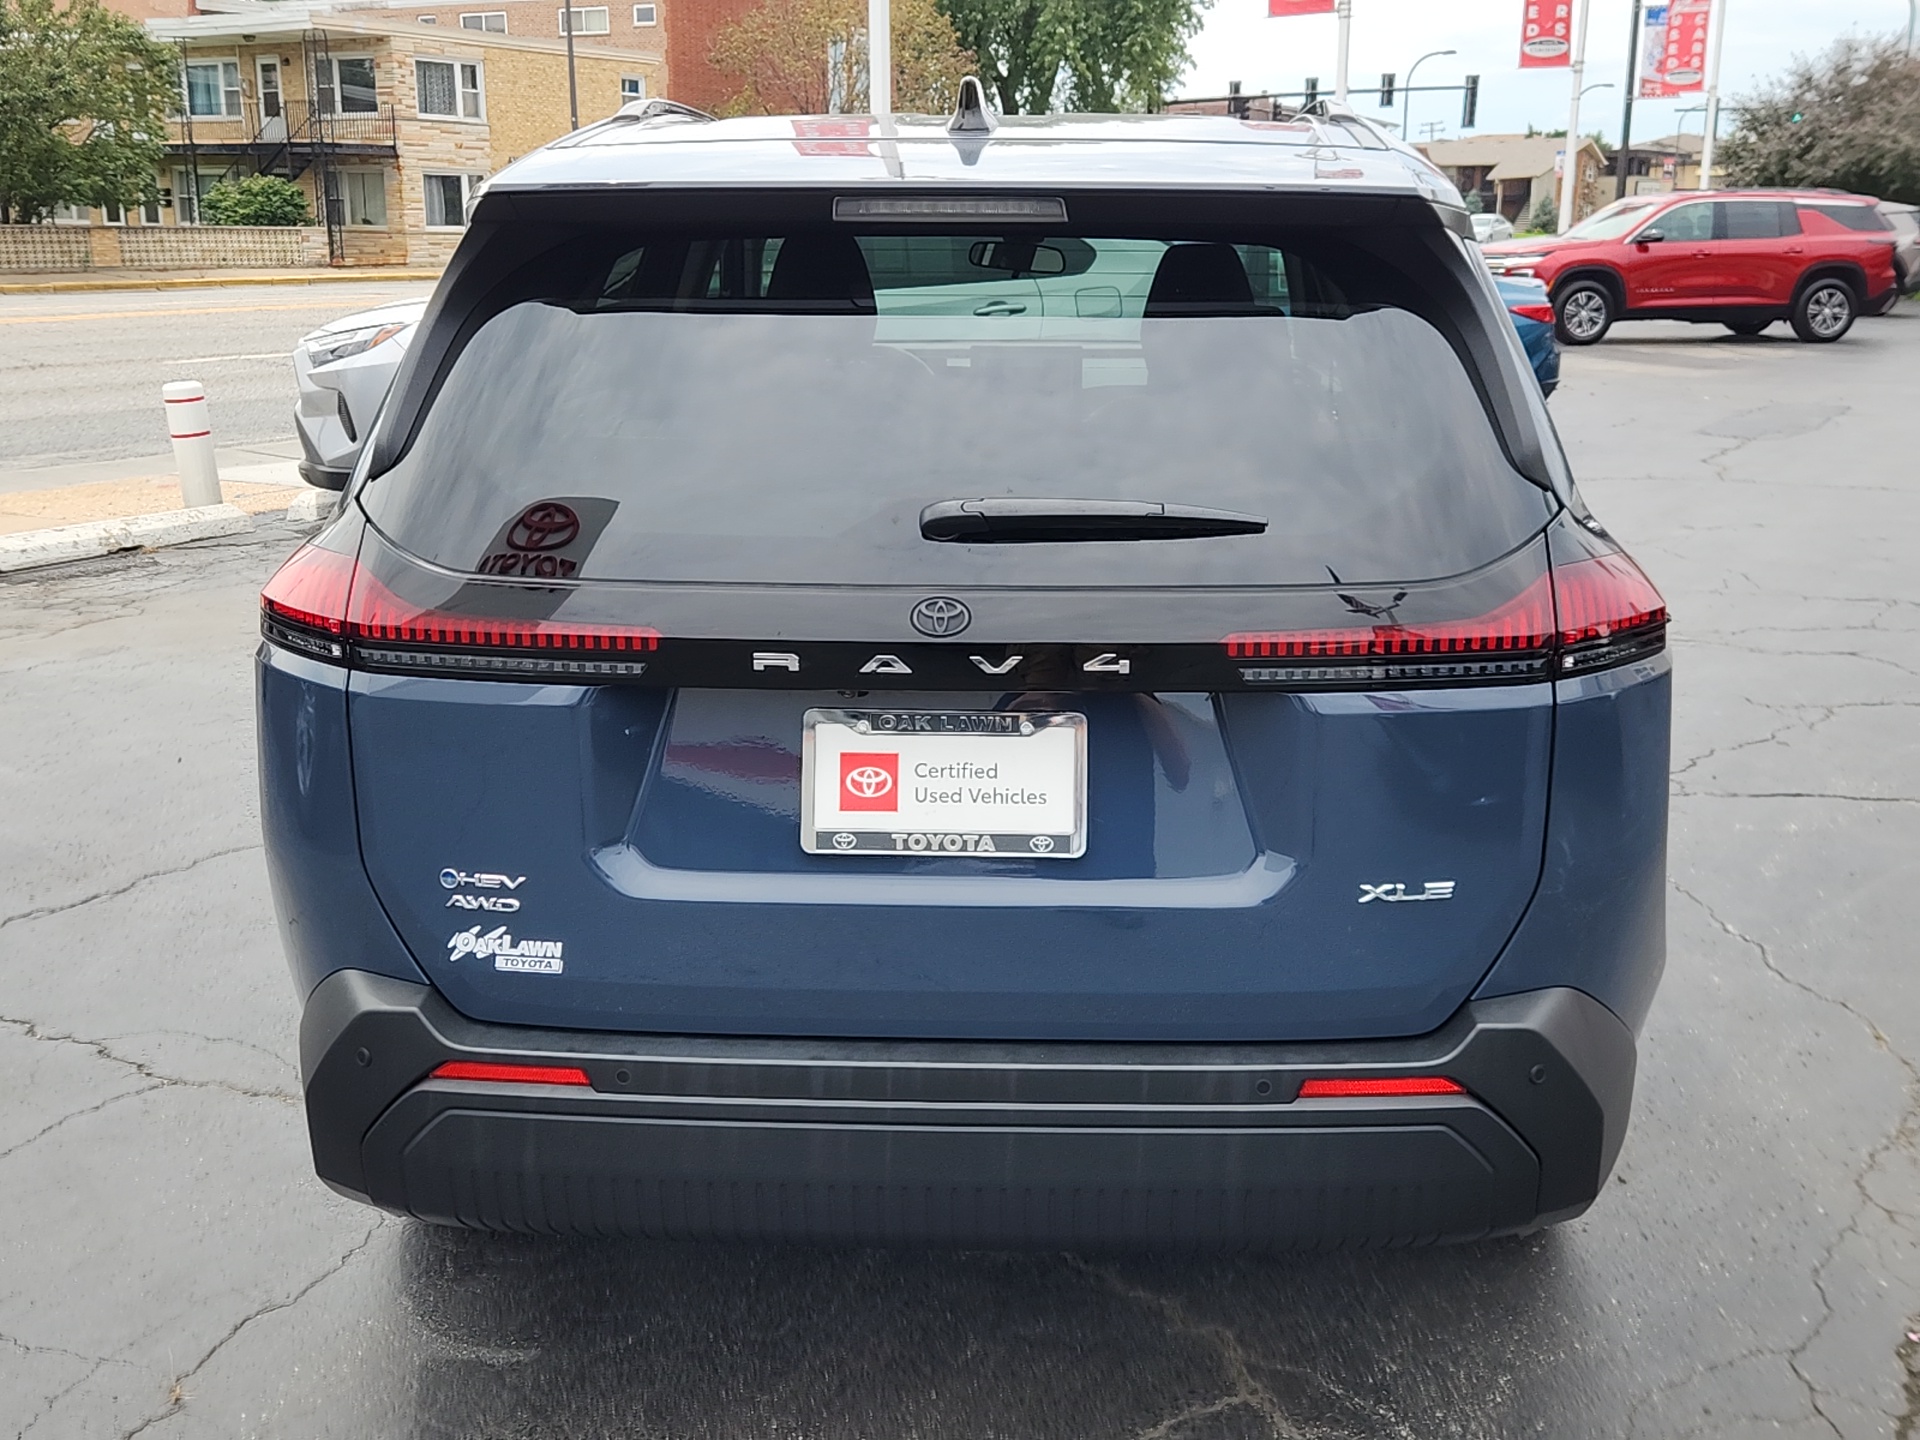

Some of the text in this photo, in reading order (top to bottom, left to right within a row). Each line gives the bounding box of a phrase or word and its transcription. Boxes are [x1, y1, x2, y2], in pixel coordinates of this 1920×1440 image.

[752, 652, 1131, 675] RAV4
[877, 714, 1015, 733] OAK LAWN
[914, 762, 999, 780] Certified
[914, 787, 1048, 806] Used Vehicles
[891, 833, 997, 852] TOYOTA
[1357, 880, 1456, 904] XLE
[445, 894, 521, 913] AWD
[503, 958, 553, 969] TOYOTA
